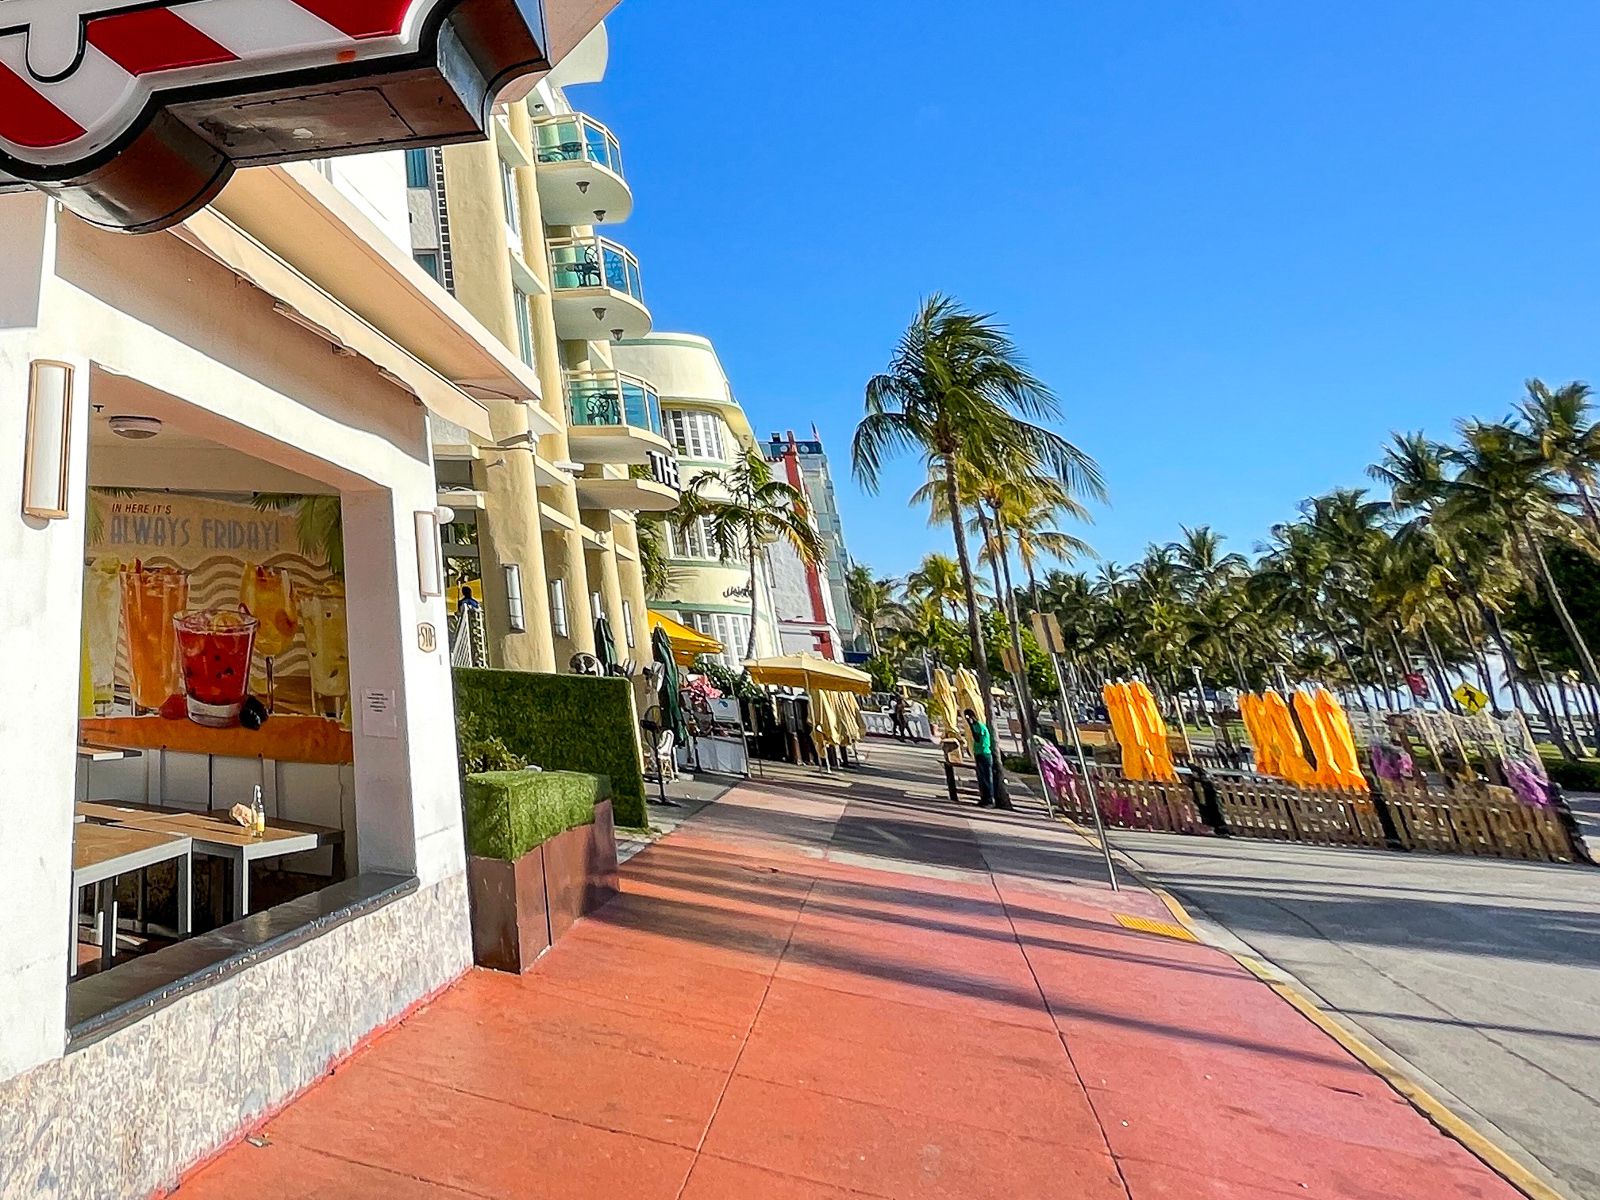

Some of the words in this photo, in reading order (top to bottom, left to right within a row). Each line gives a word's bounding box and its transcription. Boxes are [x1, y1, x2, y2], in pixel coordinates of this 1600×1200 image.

[112, 503, 121, 513] IN
[125, 504, 148, 513] HERE
[152, 504, 171, 514] IT'S
[110, 515, 190, 546] ALWAYS
[201, 518, 280, 551] FRIDAY!
